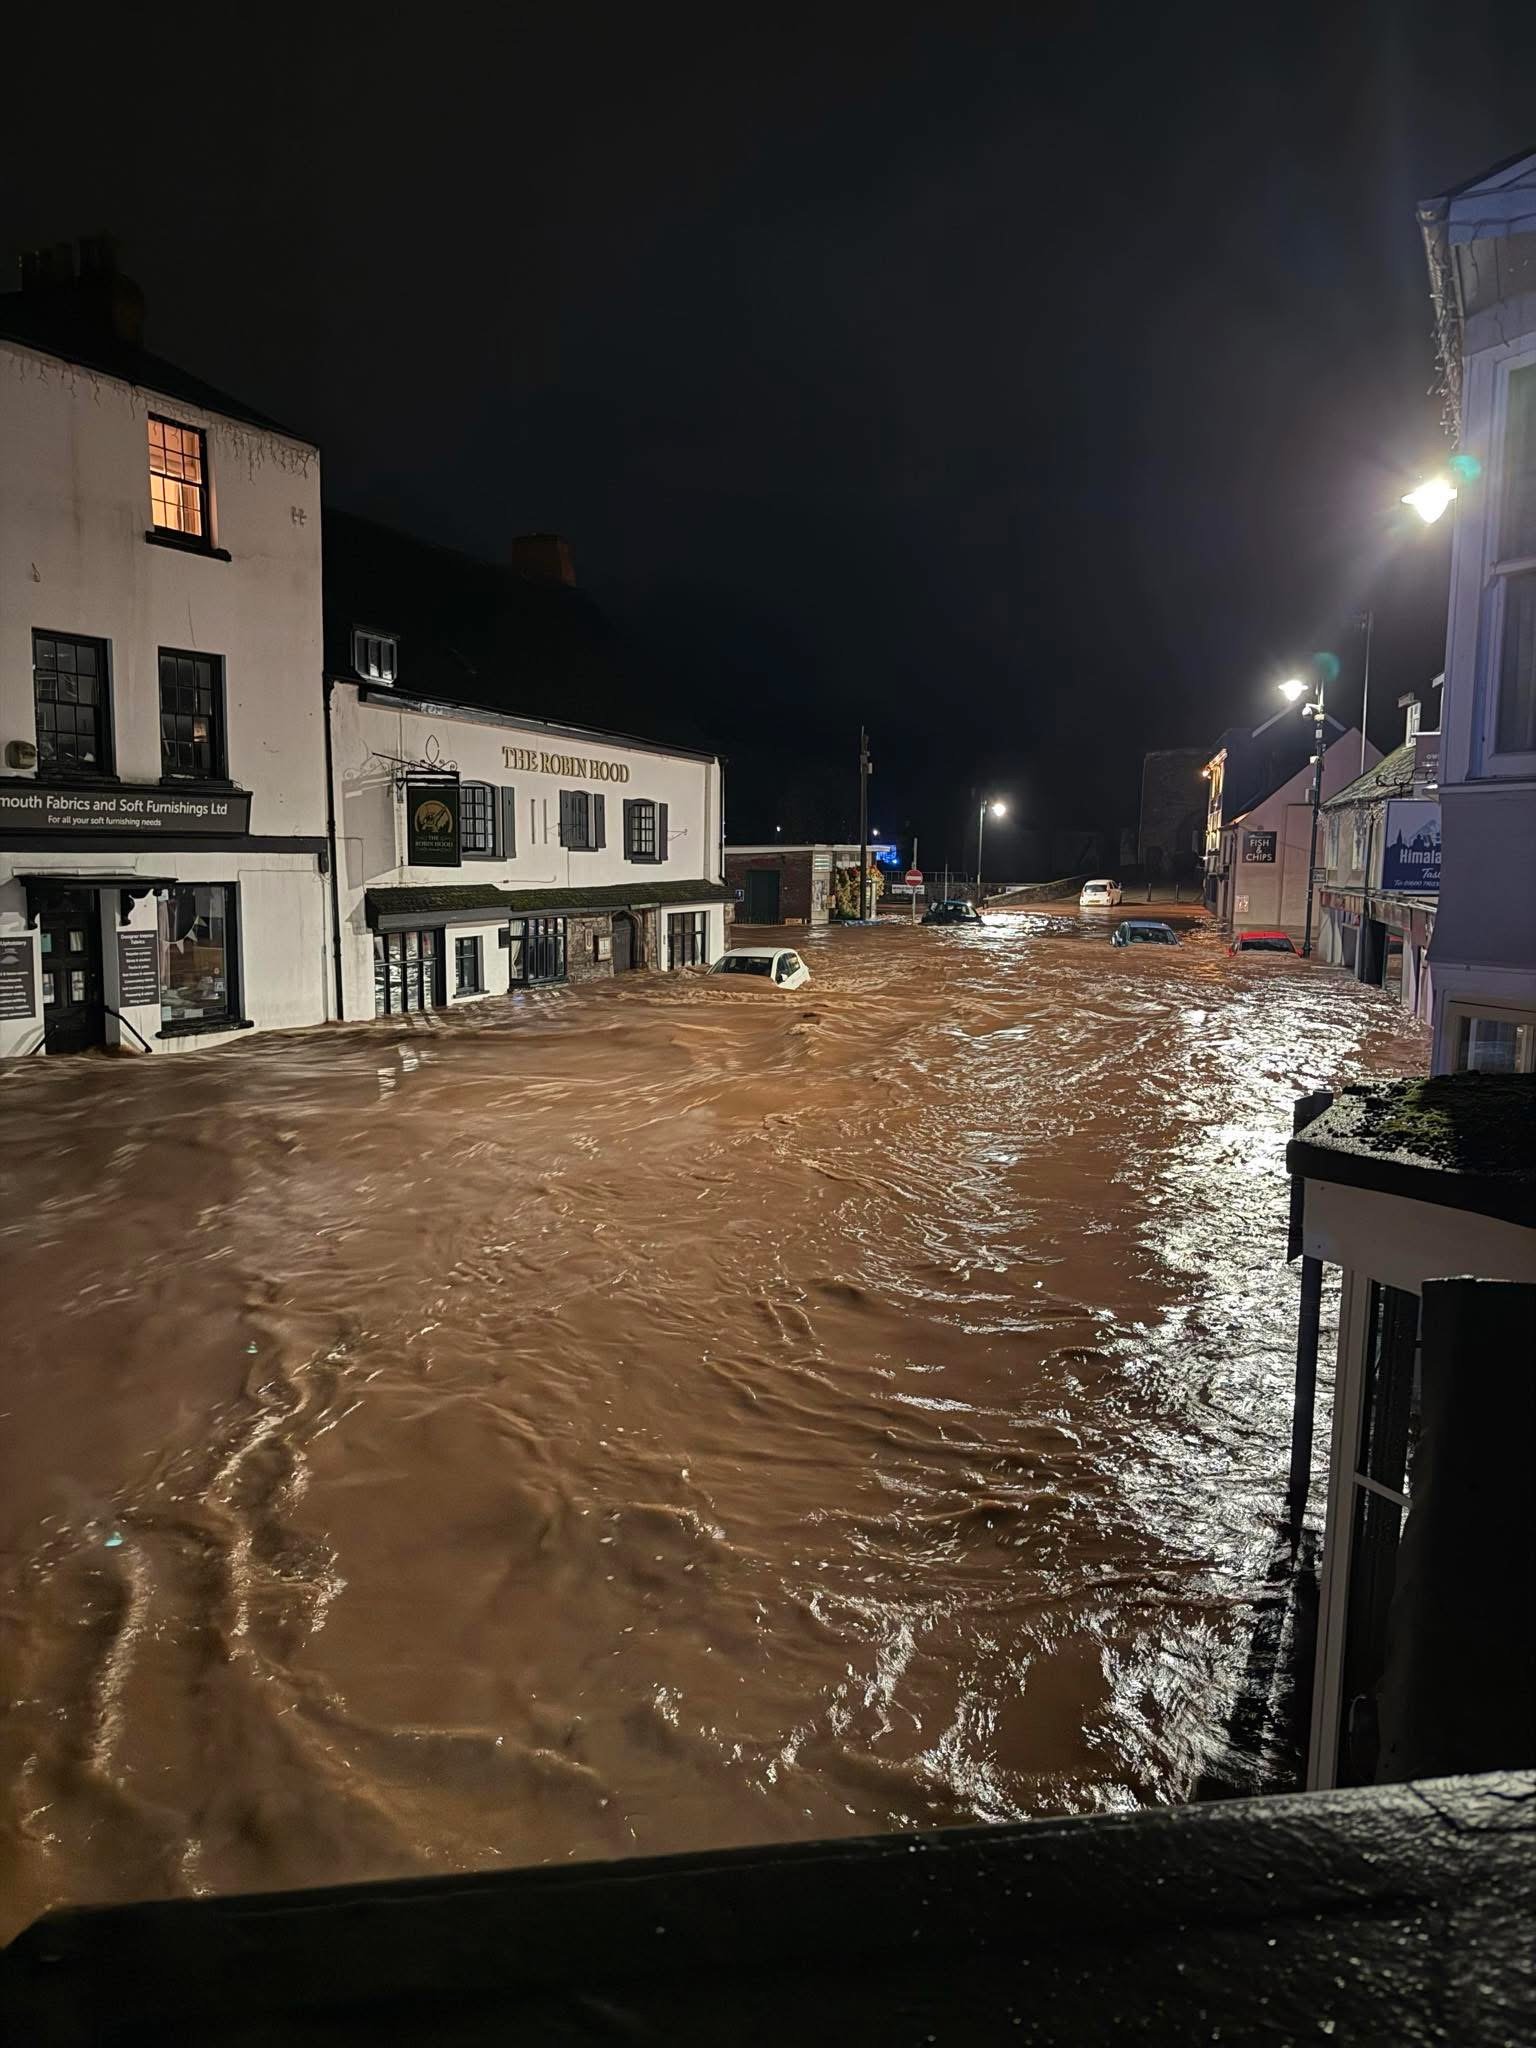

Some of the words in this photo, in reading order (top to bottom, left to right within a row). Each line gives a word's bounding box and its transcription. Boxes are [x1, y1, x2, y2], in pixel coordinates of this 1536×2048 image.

[502, 746, 539, 772] THE
[540, 752, 588, 779] ROBIN
[589, 760, 630, 783] HOOD
[46, 796, 90, 810] Fabrics
[93, 799, 117, 811] and
[120, 799, 144, 812] Soft
[146, 800, 209, 817] Furnishings
[211, 802, 228, 815] Ltd
[48, 815, 60, 824] For
[62, 816, 71, 824] all
[72, 817, 89, 826] your
[90, 816, 105, 825] soft
[106, 817, 140, 827] furnishing
[1250, 839, 1270, 847] FISH
[1255, 846, 1263, 854] &
[1245, 853, 1273, 861] CHIPS
